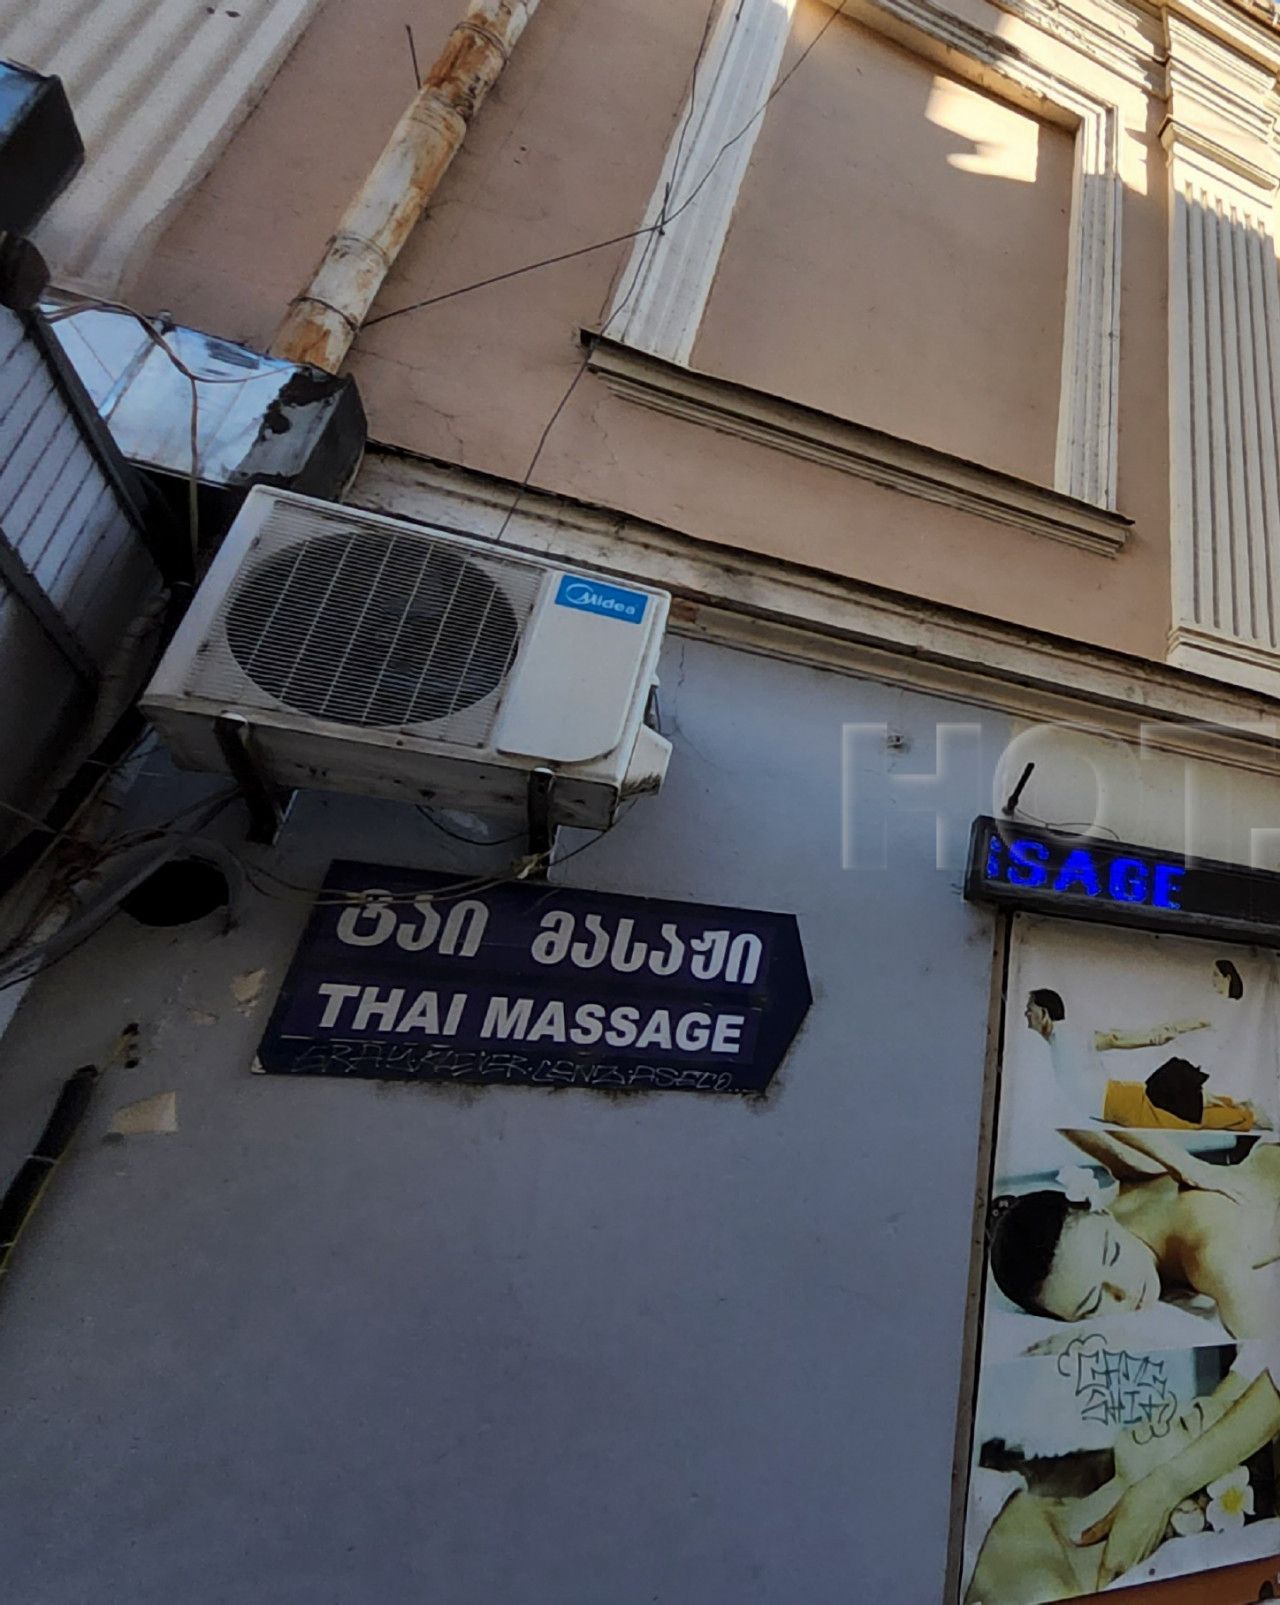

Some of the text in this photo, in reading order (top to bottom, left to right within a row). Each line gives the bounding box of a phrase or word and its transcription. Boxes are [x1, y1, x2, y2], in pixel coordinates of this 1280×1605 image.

[566, 583, 636, 615] Midea
[336, 888, 764, 985] ტაი მასაჟი
[318, 983, 746, 1053] THAI MASSAGE
